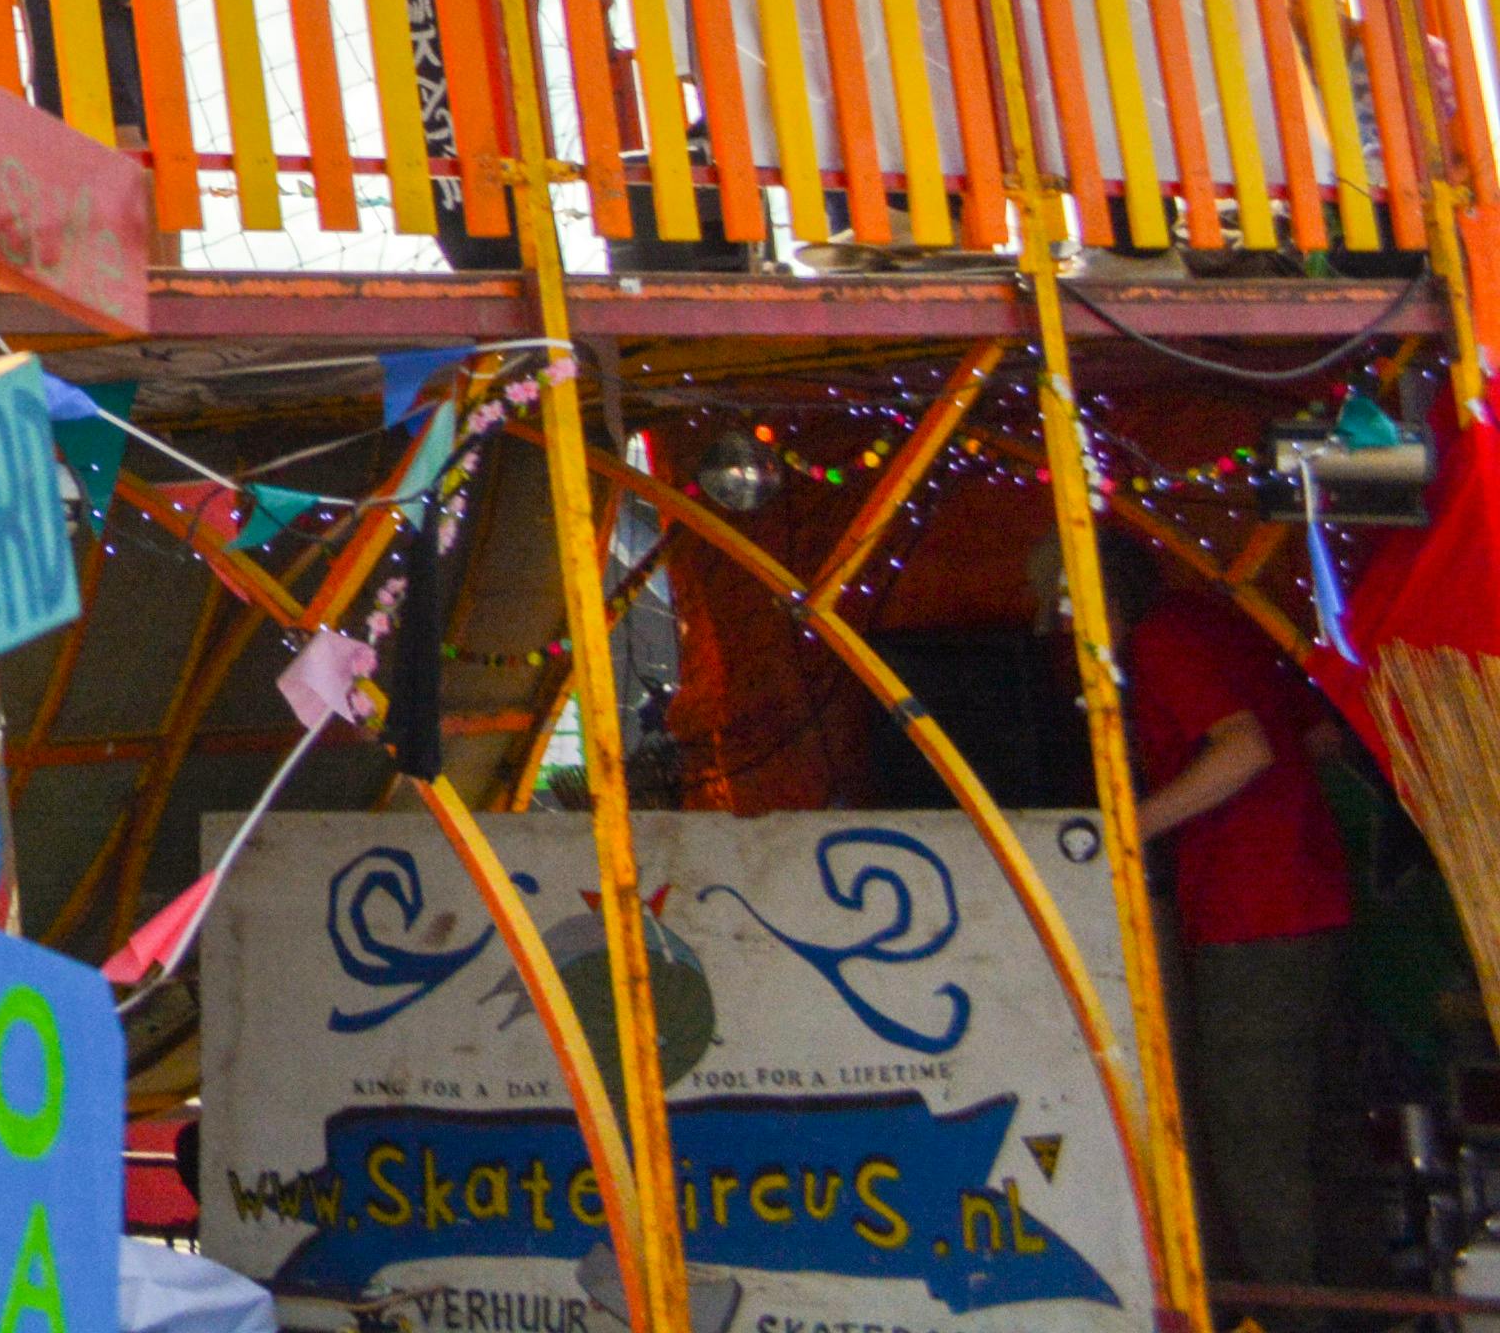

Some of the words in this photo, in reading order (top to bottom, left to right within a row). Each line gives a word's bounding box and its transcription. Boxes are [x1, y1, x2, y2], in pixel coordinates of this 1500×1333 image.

[756, 1067, 804, 1088] FOR
[811, 1069, 826, 1087] A
[838, 1061, 952, 1085] LIFETIME
[421, 1079, 461, 1098] FOR
[476, 1081, 489, 1098] A
[506, 1080, 550, 1098] DAY
[414, 1286, 587, 1333] VERHUUR
